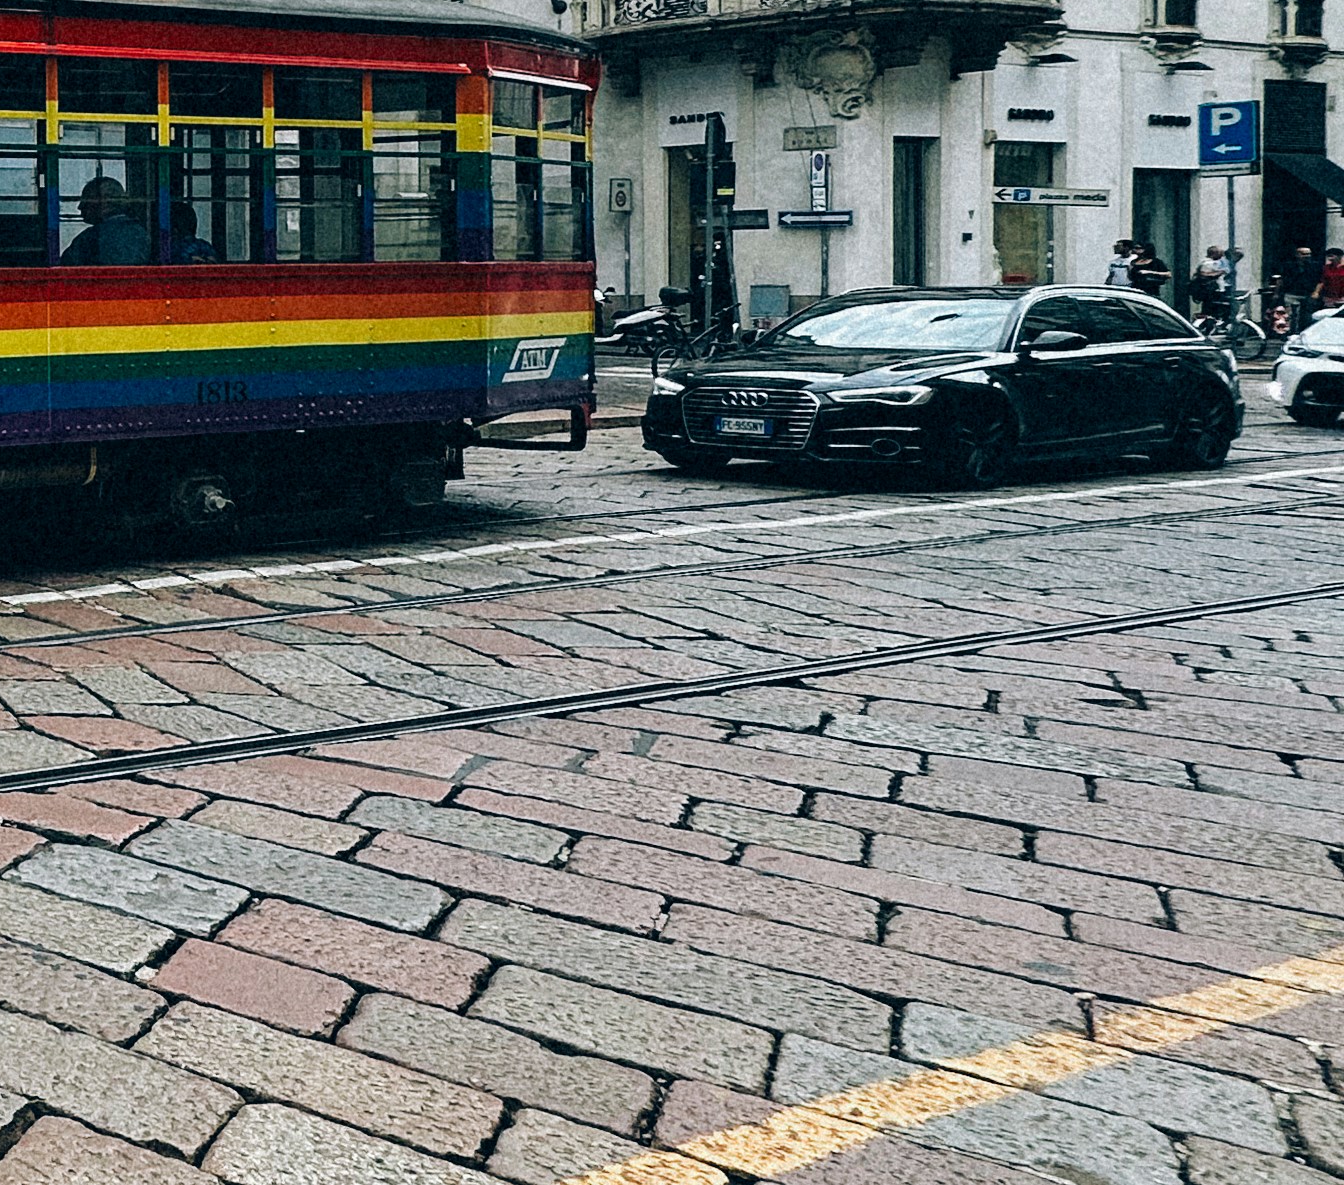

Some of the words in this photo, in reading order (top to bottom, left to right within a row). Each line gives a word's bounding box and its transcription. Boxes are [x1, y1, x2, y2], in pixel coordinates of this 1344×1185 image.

[668, 112, 721, 125] SAND
[521, 349, 547, 370] ATM
[197, 381, 249, 406] 1813
